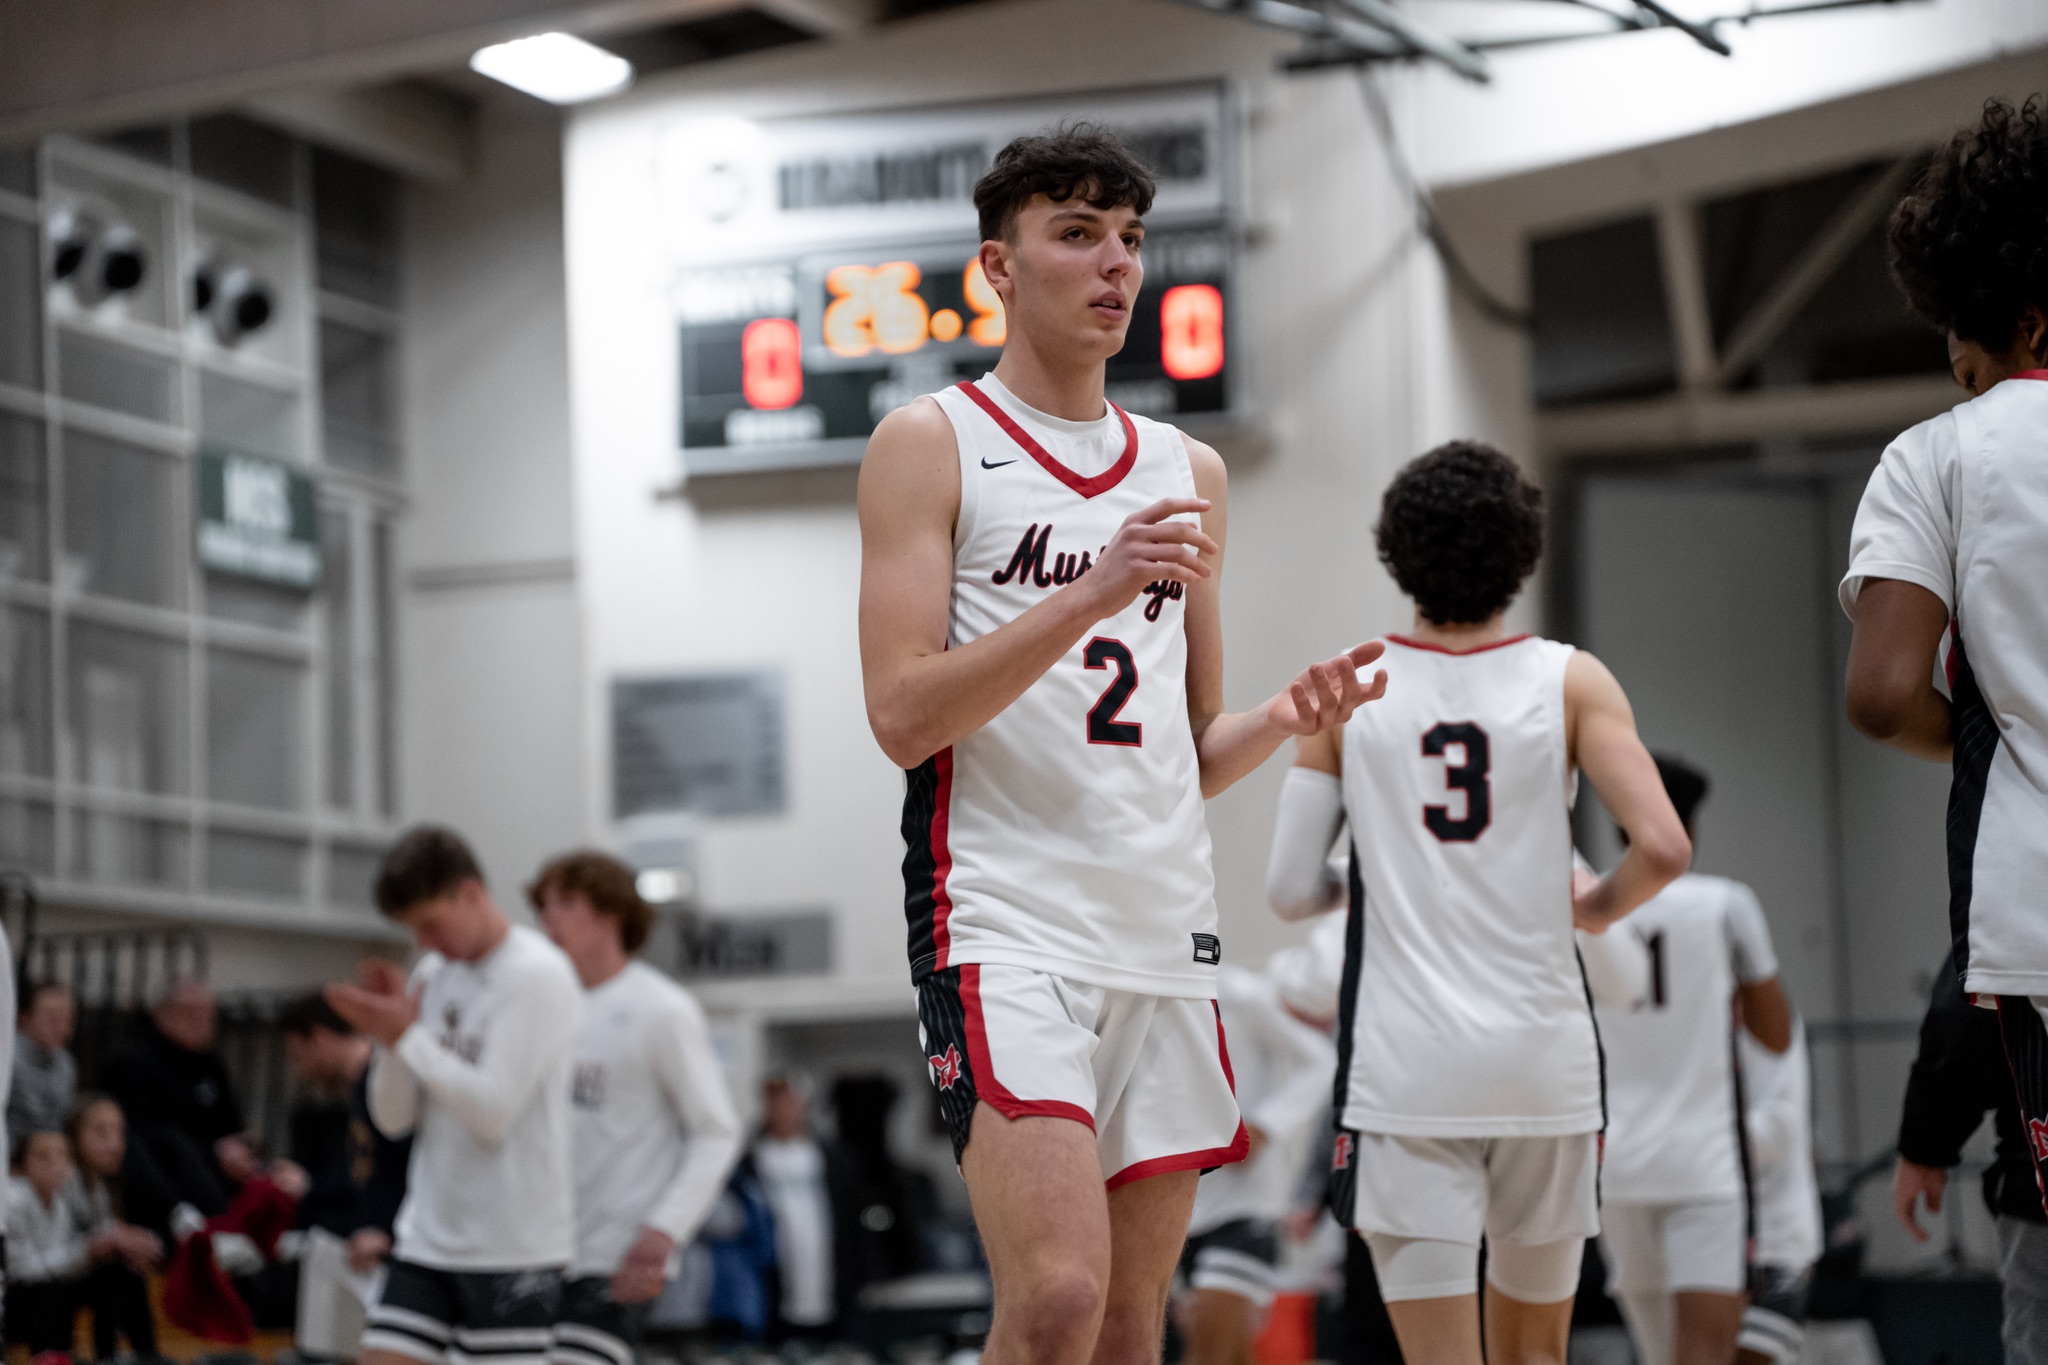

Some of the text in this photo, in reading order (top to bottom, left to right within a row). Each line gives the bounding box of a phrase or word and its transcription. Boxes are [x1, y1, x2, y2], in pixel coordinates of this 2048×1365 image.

[742, 318, 802, 410] 0
[1160, 284, 1224, 380] 0
[1083, 636, 1142, 748] 2
[1421, 721, 1492, 843] 3
